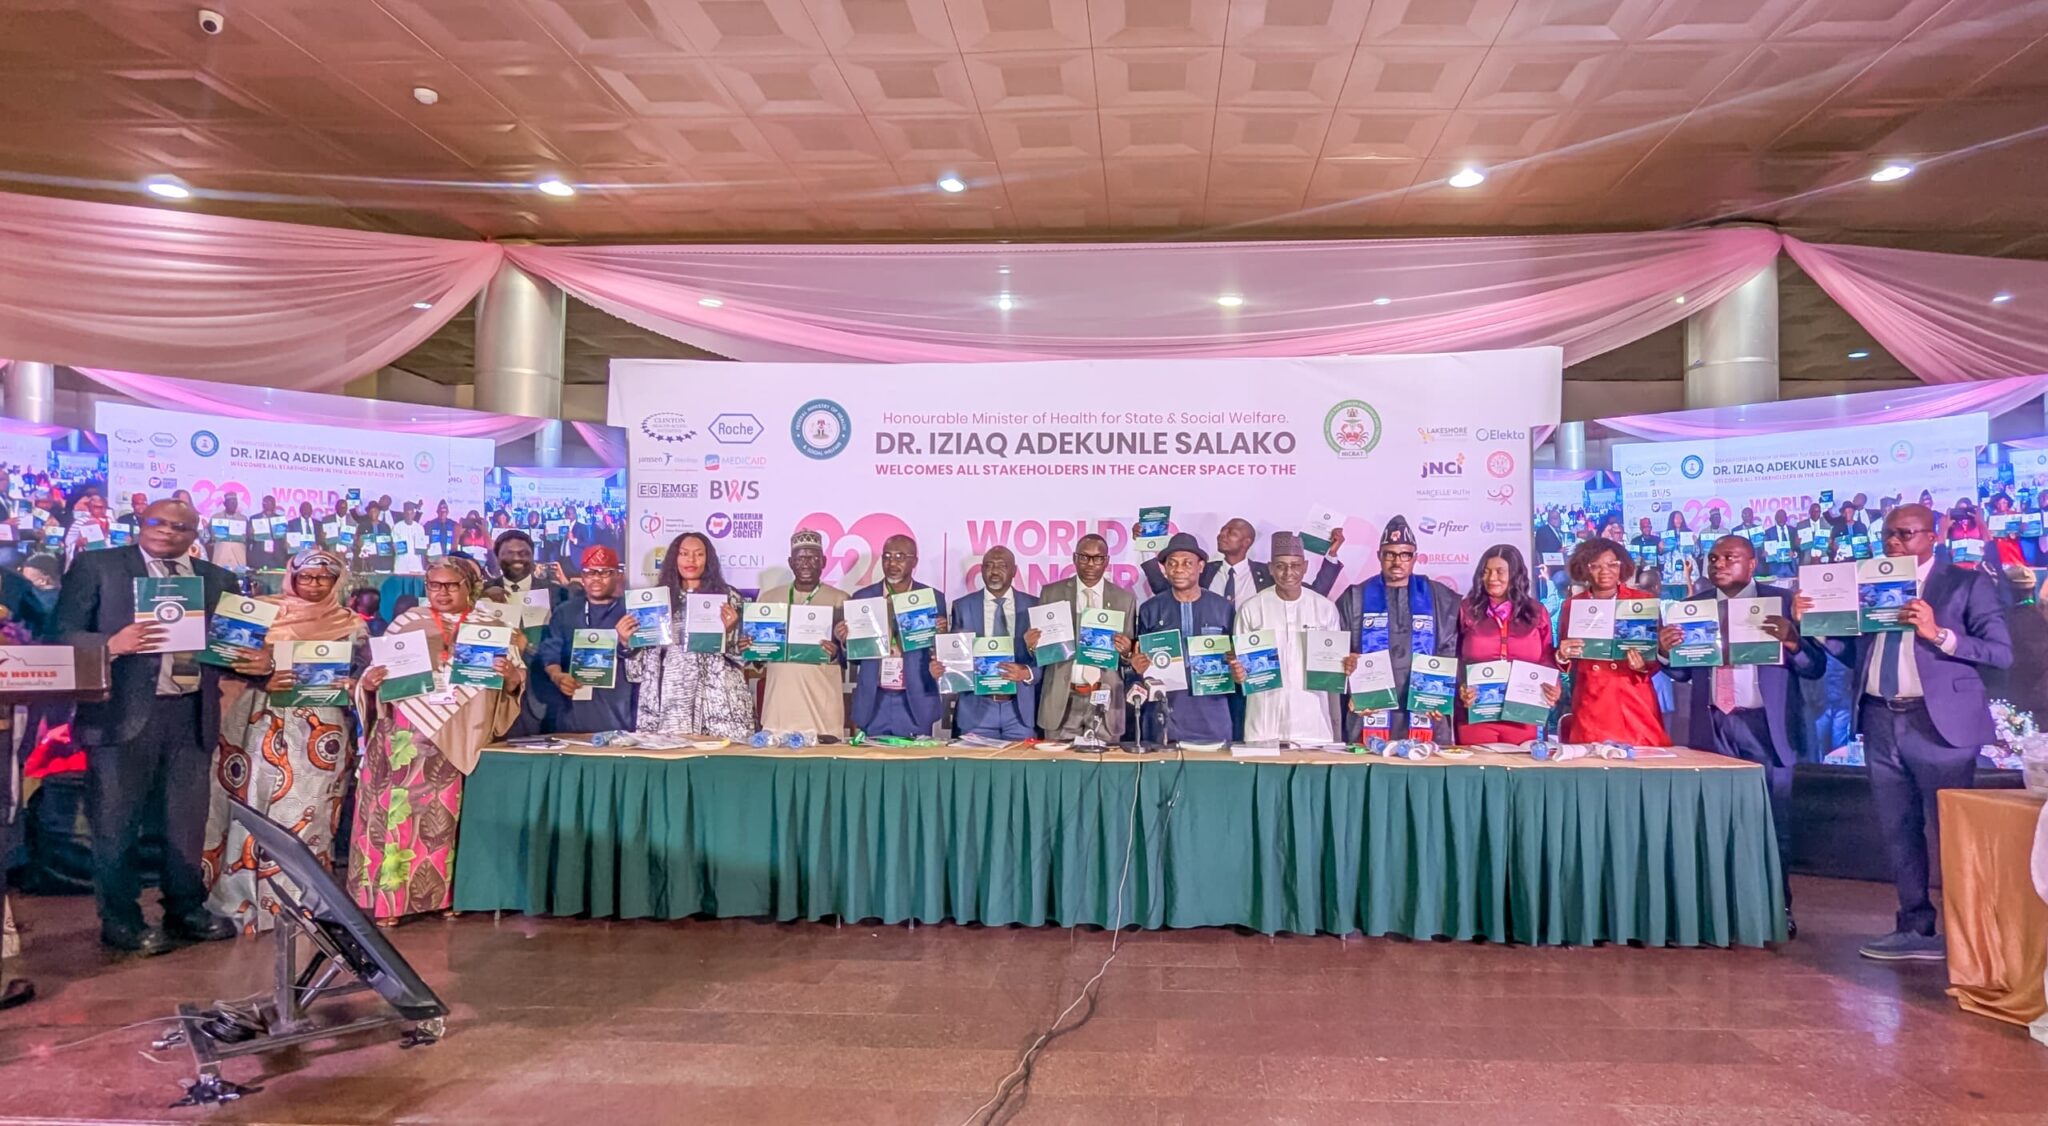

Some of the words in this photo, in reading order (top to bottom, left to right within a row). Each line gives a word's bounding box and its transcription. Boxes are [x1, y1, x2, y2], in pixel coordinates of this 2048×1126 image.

[883, 412, 968, 424] Honourable
[972, 412, 1029, 424] Minister
[1032, 412, 1047, 424] of
[1050, 412, 1097, 424] Health
[1101, 412, 1121, 424] for
[1125, 412, 1163, 424] State
[1167, 412, 1177, 424] &
[1181, 412, 1224, 424] Social
[1229, 411, 1289, 424] Welfare.
[718, 422, 754, 435] Roche
[1490, 430, 1525, 440] Elekta
[875, 432, 922, 454] DR.
[929, 432, 1008, 458] IZIAQ
[1014, 432, 1168, 454] ADEKUNLE
[1175, 431, 1296, 454] SALAKO
[230, 447, 252, 459] DR.
[255, 449, 290, 463] IZIAQ
[292, 453, 356, 467] ADEKUNLE
[358, 458, 405, 470] SALAKO
[722, 456, 767, 465] MEDICAID
[875, 464, 953, 475] WELCOMES
[957, 464, 980, 475] ALL
[982, 464, 1089, 475] STAKEHOLDERS
[1092, 464, 1106, 475] IN
[1109, 464, 1135, 475] THE
[1138, 464, 1196, 475] CANCER
[1199, 464, 1245, 475] SPACE
[1250, 464, 1267, 475] TO
[1270, 464, 1297, 475] THE
[1713, 466, 1731, 476] DR.
[1733, 463, 1764, 475] IZIAQ
[1766, 458, 1828, 472] ADEKUNLE
[1830, 455, 1879, 468] SALAKO
[662, 484, 698, 493] EMGE
[710, 480, 760, 502] BWS
[733, 521, 763, 530] CANCER
[1438, 520, 1470, 537] Pfizer
[733, 530, 763, 538] SOCIETY
